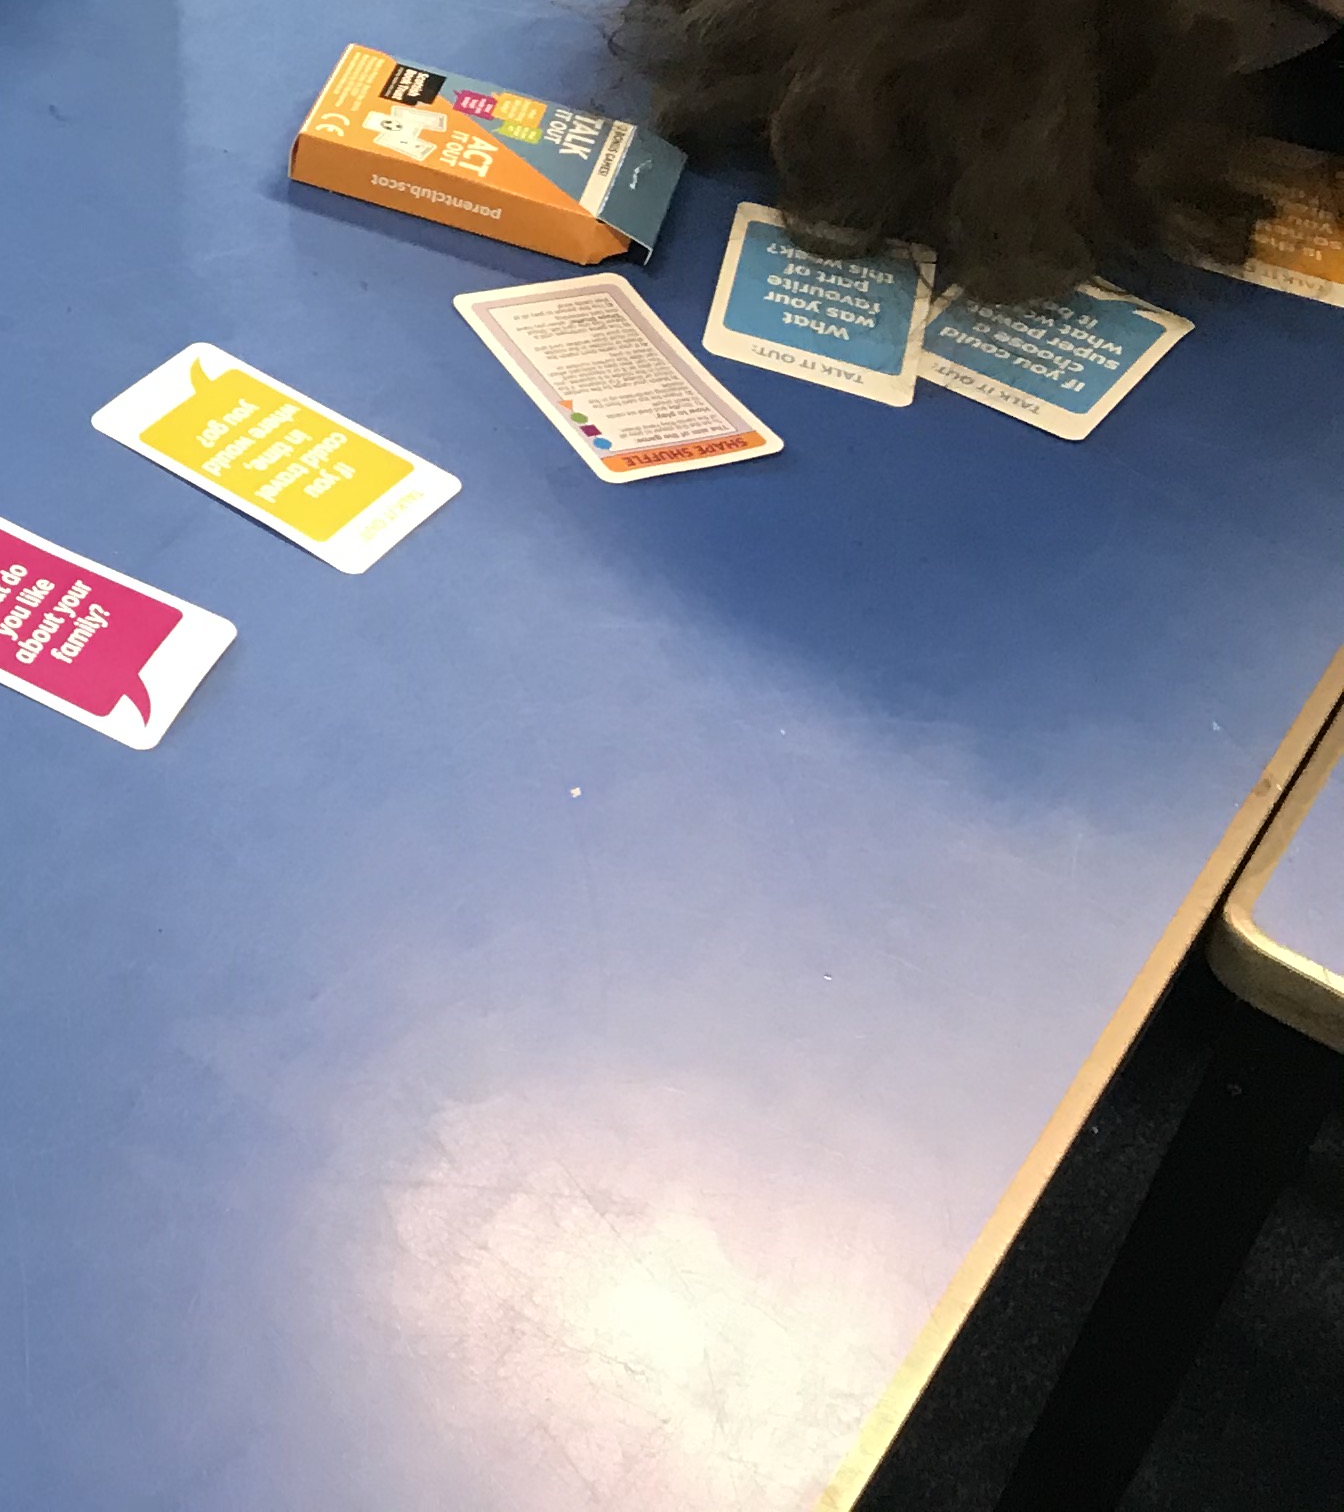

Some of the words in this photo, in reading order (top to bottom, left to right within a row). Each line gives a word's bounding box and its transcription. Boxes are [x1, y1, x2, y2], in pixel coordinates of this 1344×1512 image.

[555, 109, 573, 122] IT
[451, 130, 470, 143] IT
[544, 121, 567, 144] OUT
[559, 115, 603, 160] TALK
[608, 130, 626, 153] BONUS
[439, 142, 464, 167] OUT
[458, 136, 498, 177] ACT
[598, 153, 616, 177] GAMES!
[371, 174, 502, 220] parentclub.scot
[783, 263, 810, 276] of
[849, 264, 894, 284] this
[816, 271, 869, 292] part
[763, 291, 822, 313] your
[766, 275, 880, 315] favourite
[782, 312, 849, 340] What
[826, 307, 875, 328] was
[939, 326, 1011, 359] could
[1059, 325, 1123, 355] what
[751, 343, 796, 364] OUT:
[994, 332, 1085, 372] choose
[1047, 338, 1120, 370] super
[799, 359, 816, 370] IT
[821, 364, 864, 384] TALK
[1013, 354, 1065, 381] you
[976, 384, 995, 394] IT
[1061, 379, 1086, 392] If
[999, 391, 1040, 414] TALK
[622, 447, 694, 467] SHUFFLE
[693, 437, 748, 455] SHAPE
[0, 564, 28, 586] do
[15, 579, 55, 608] like
[16, 612, 65, 664] about
[53, 580, 92, 618] your
[50, 603, 110, 664] family?
